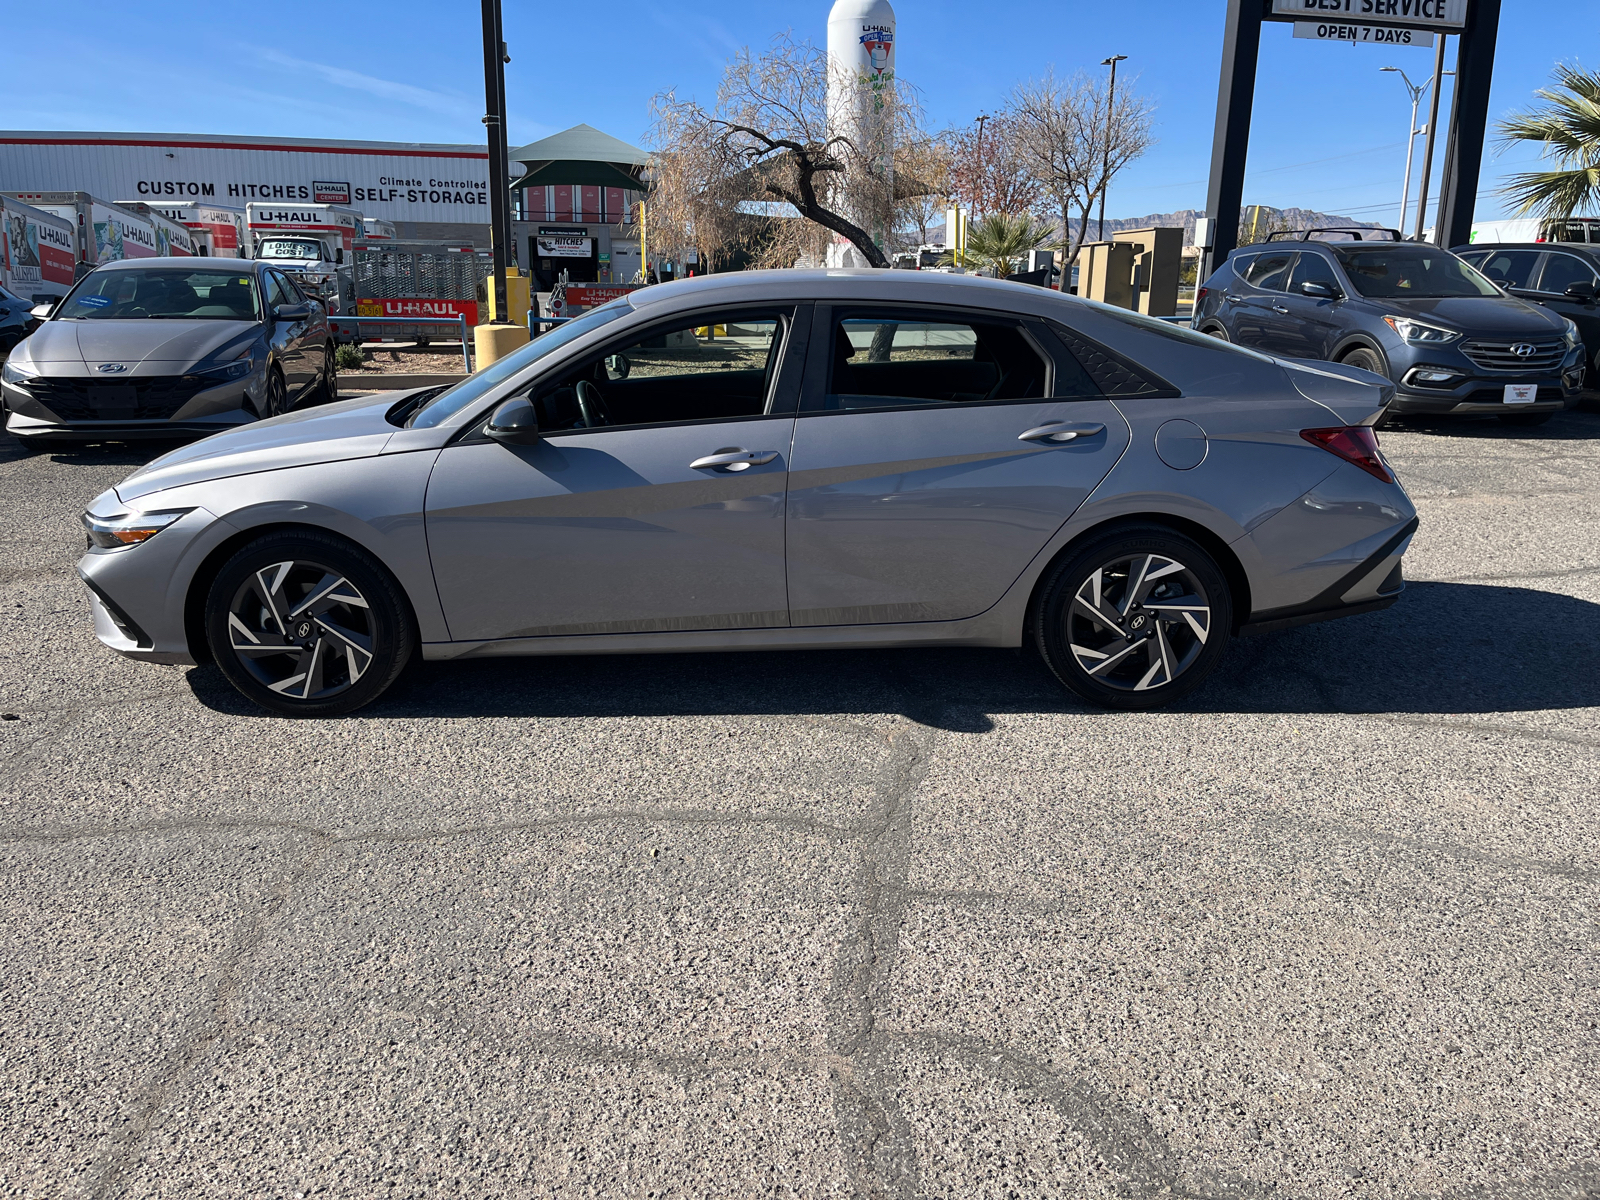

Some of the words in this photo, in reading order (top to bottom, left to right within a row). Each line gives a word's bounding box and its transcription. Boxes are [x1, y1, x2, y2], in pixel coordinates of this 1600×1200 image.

[1362, 0, 1446, 19] SERVICE
[862, 25, 892, 33] U-HAUL
[1317, 24, 1358, 40] OPEN
[1362, 28, 1371, 41] 7
[1374, 29, 1412, 44] DAYS
[379, 177, 423, 187] Climate
[429, 179, 486, 189] Controlled
[137, 181, 215, 196] CUSTOM
[228, 183, 309, 199] HITCHES
[354, 188, 487, 204] SELF-STORAGE
[260, 212, 322, 222] U-HAUL
[40, 225, 71, 248] U-HAUL
[122, 223, 154, 247] U-HAUL
[169, 229, 191, 251] U-HAUL
[269, 243, 314, 252] LOWEST
[555, 238, 584, 246] HITCHES
[275, 248, 303, 256] COST
[386, 302, 458, 315] U-HAUL
[1121, 540, 1166, 549] KUMHO
